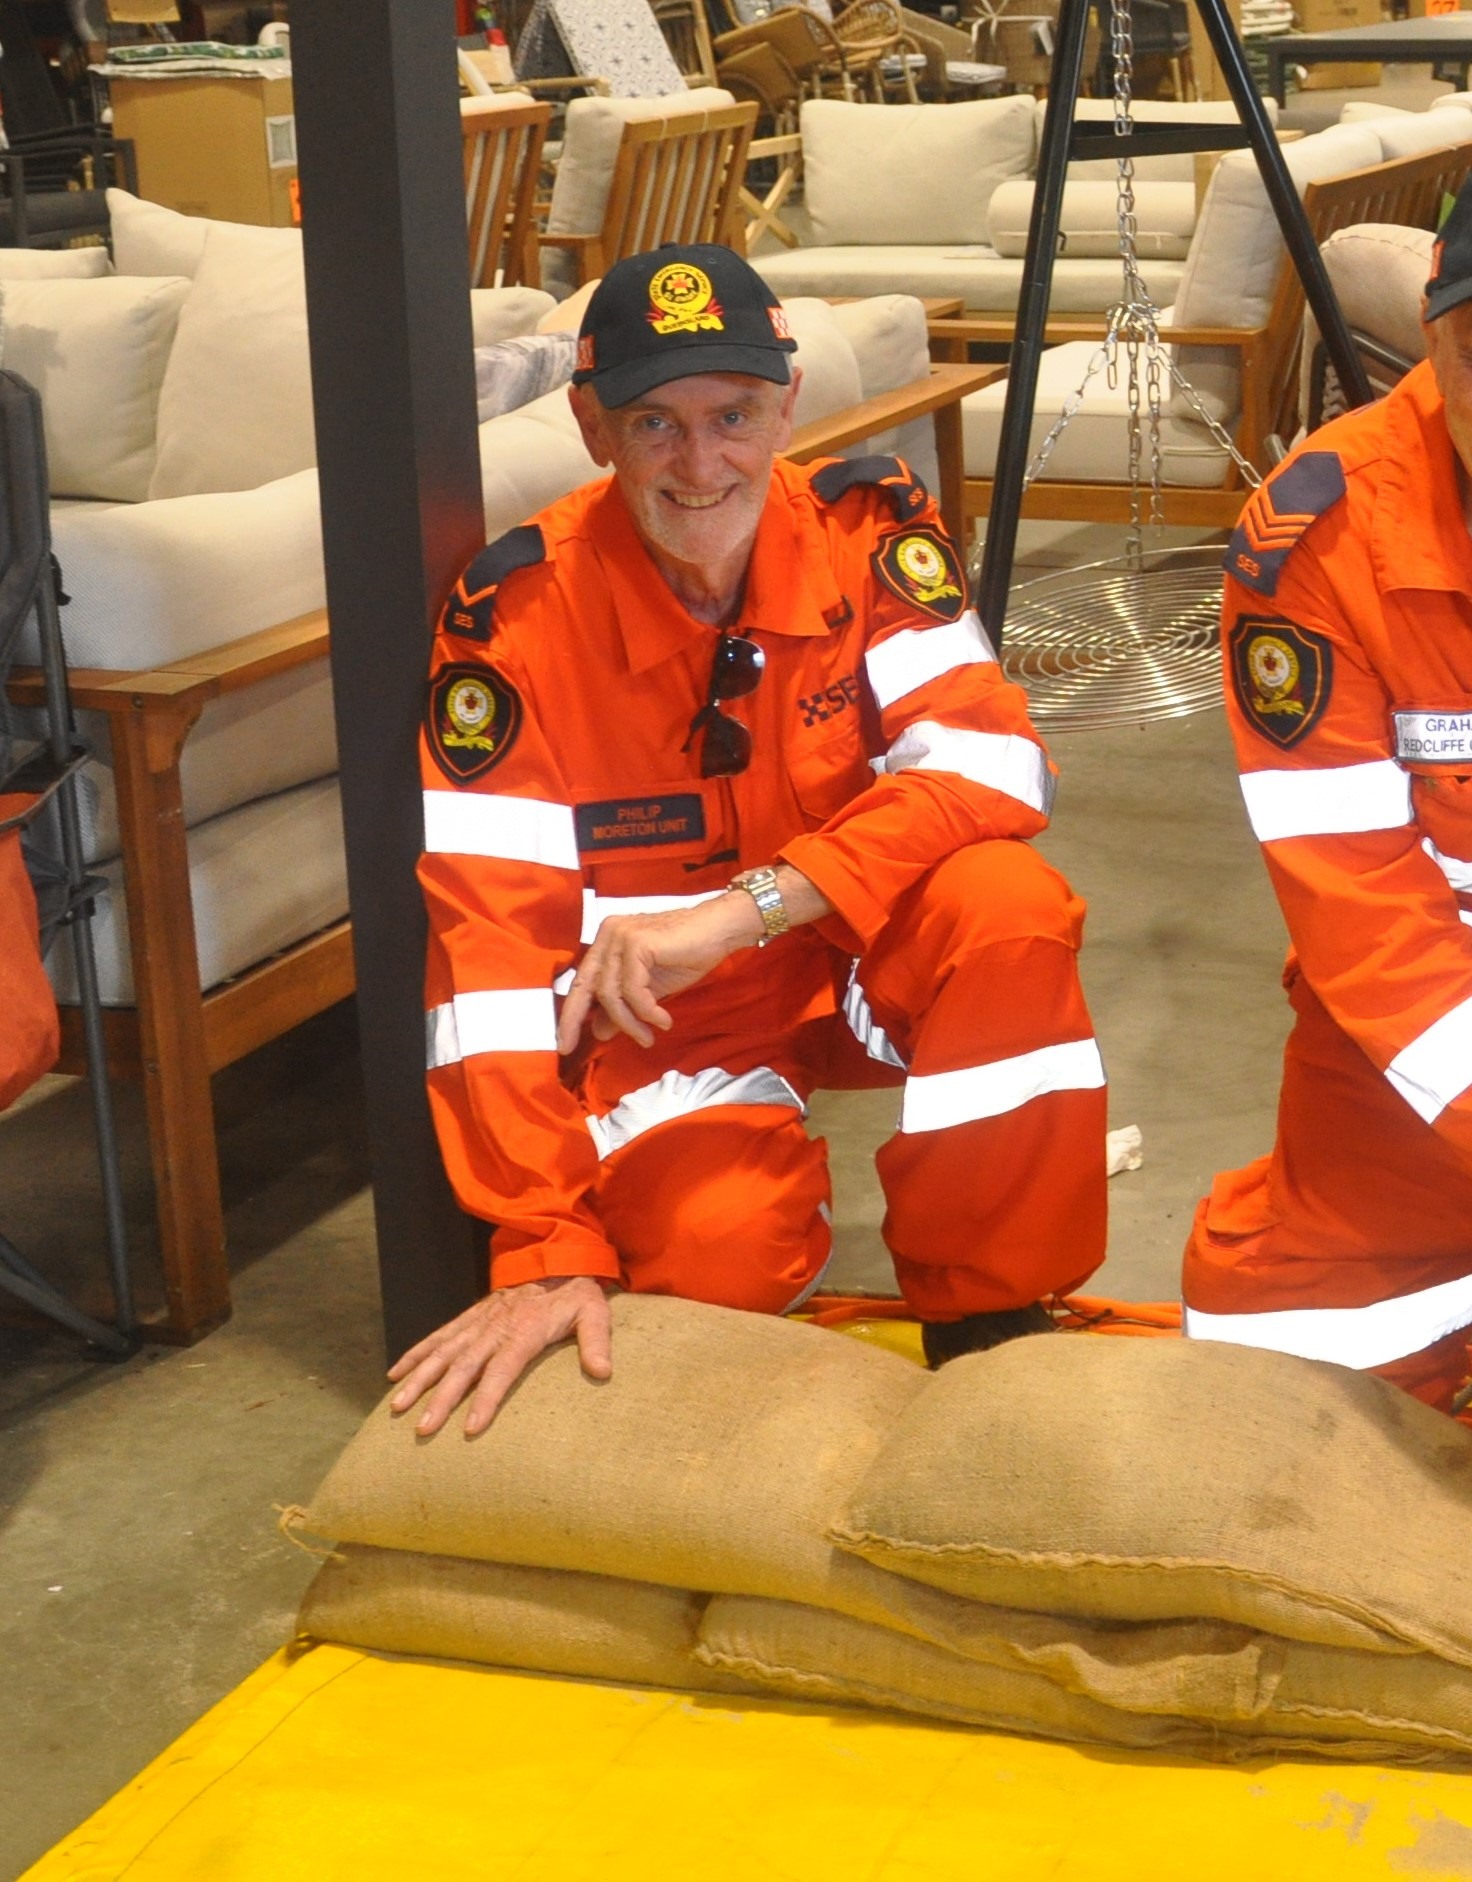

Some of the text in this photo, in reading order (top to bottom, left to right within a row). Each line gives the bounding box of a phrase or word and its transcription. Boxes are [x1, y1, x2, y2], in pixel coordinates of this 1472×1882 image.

[1403, 737, 1465, 753] REDCLIFFE
[617, 805, 662, 821] PHILIP
[591, 817, 689, 839] MORETON UNIT
